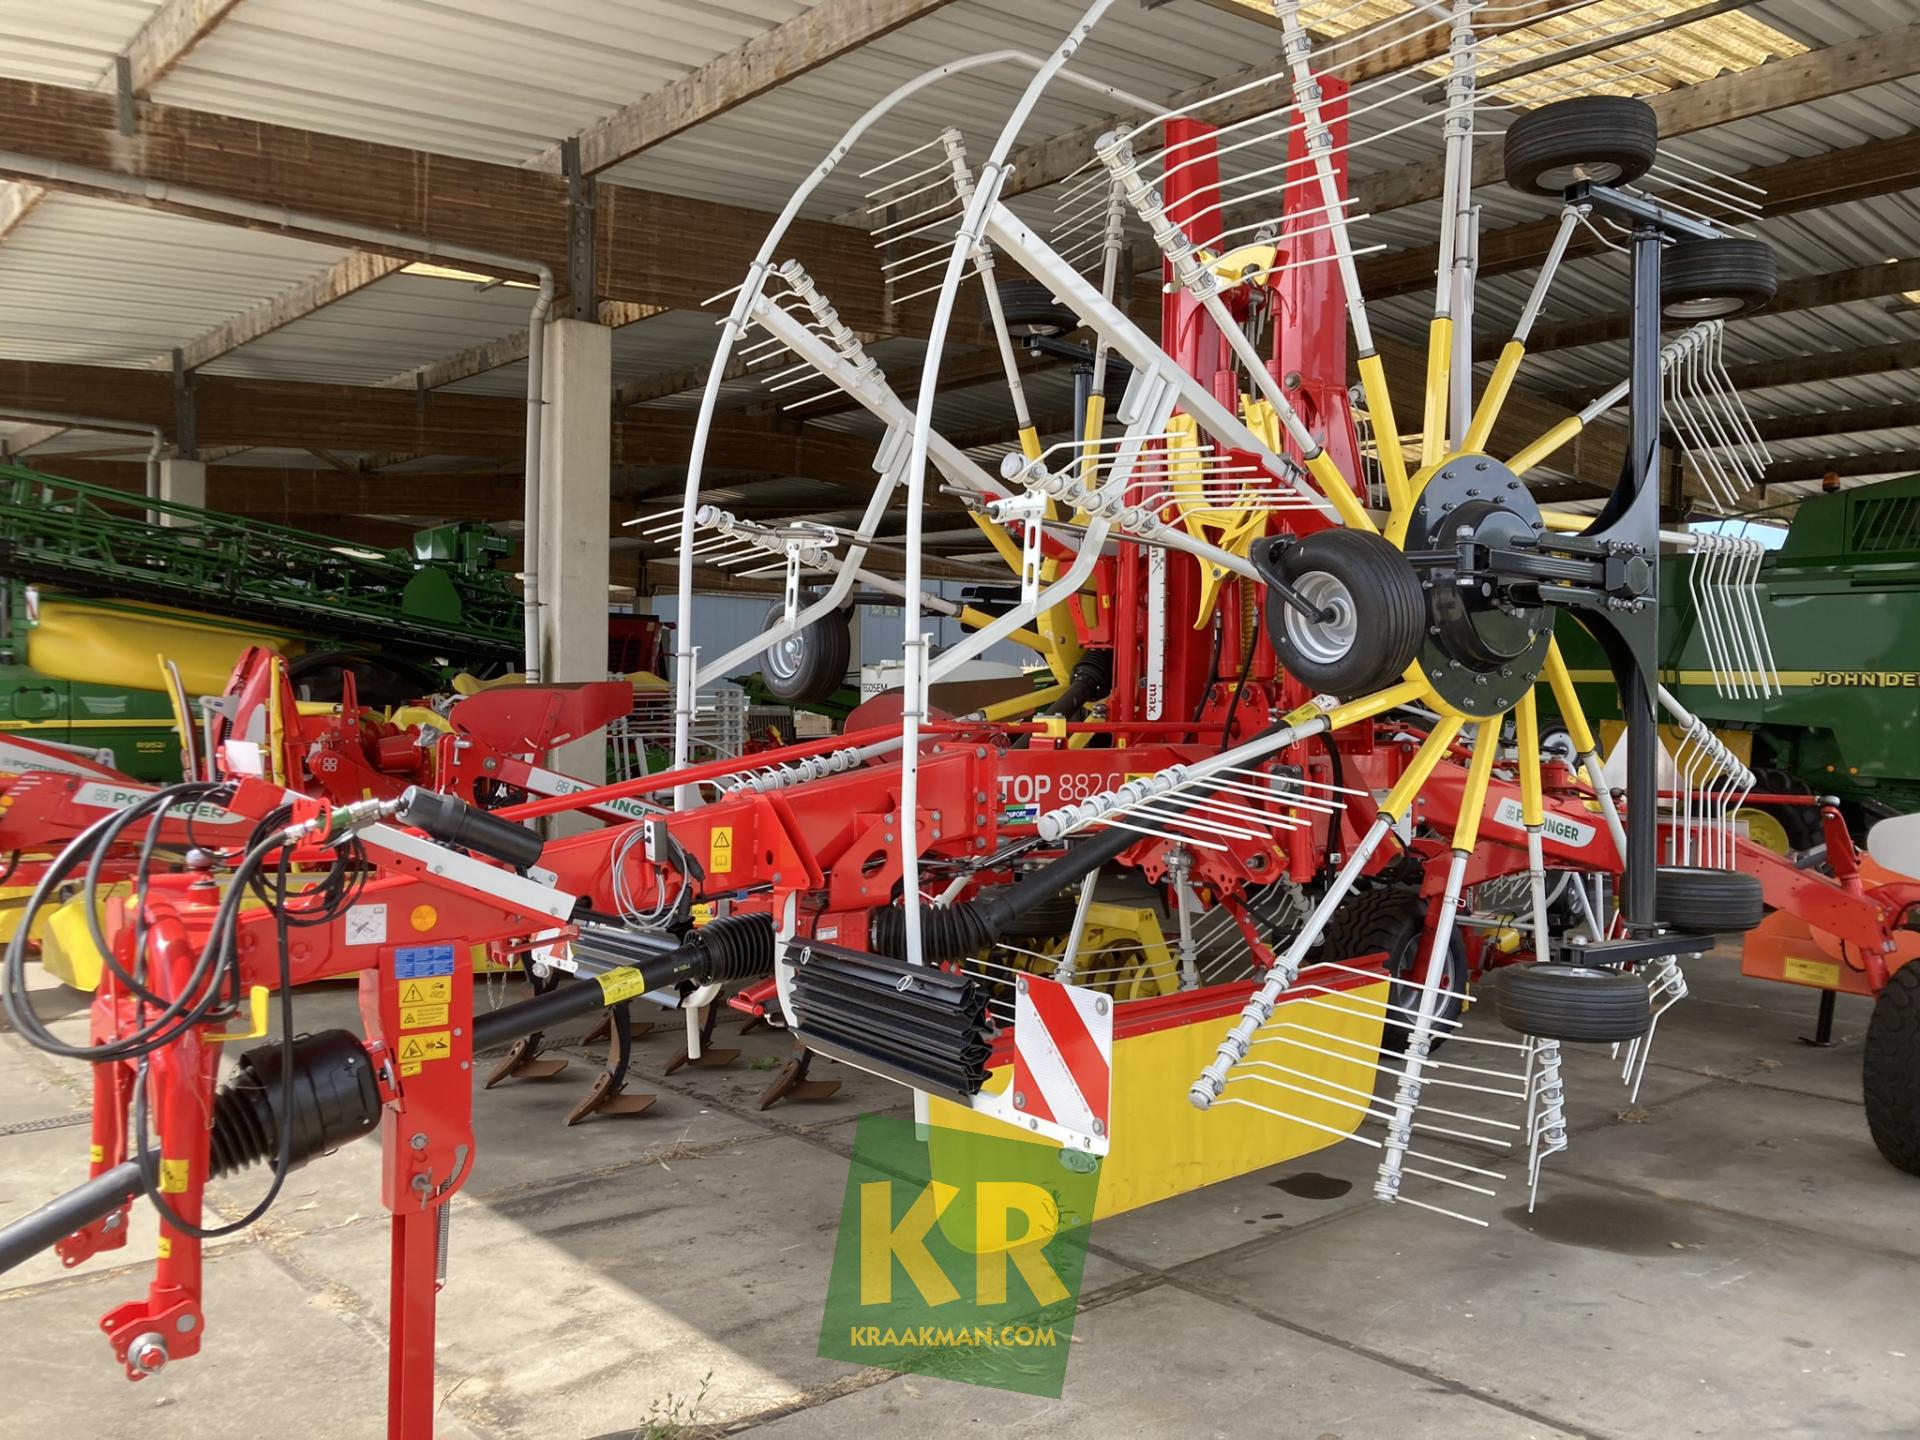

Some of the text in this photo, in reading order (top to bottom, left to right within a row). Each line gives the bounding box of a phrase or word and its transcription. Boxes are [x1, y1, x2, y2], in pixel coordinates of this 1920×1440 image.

[1812, 673, 1920, 687] JOHN DE
[1149, 684, 1157, 713] max
[997, 774, 1051, 803] TOP
